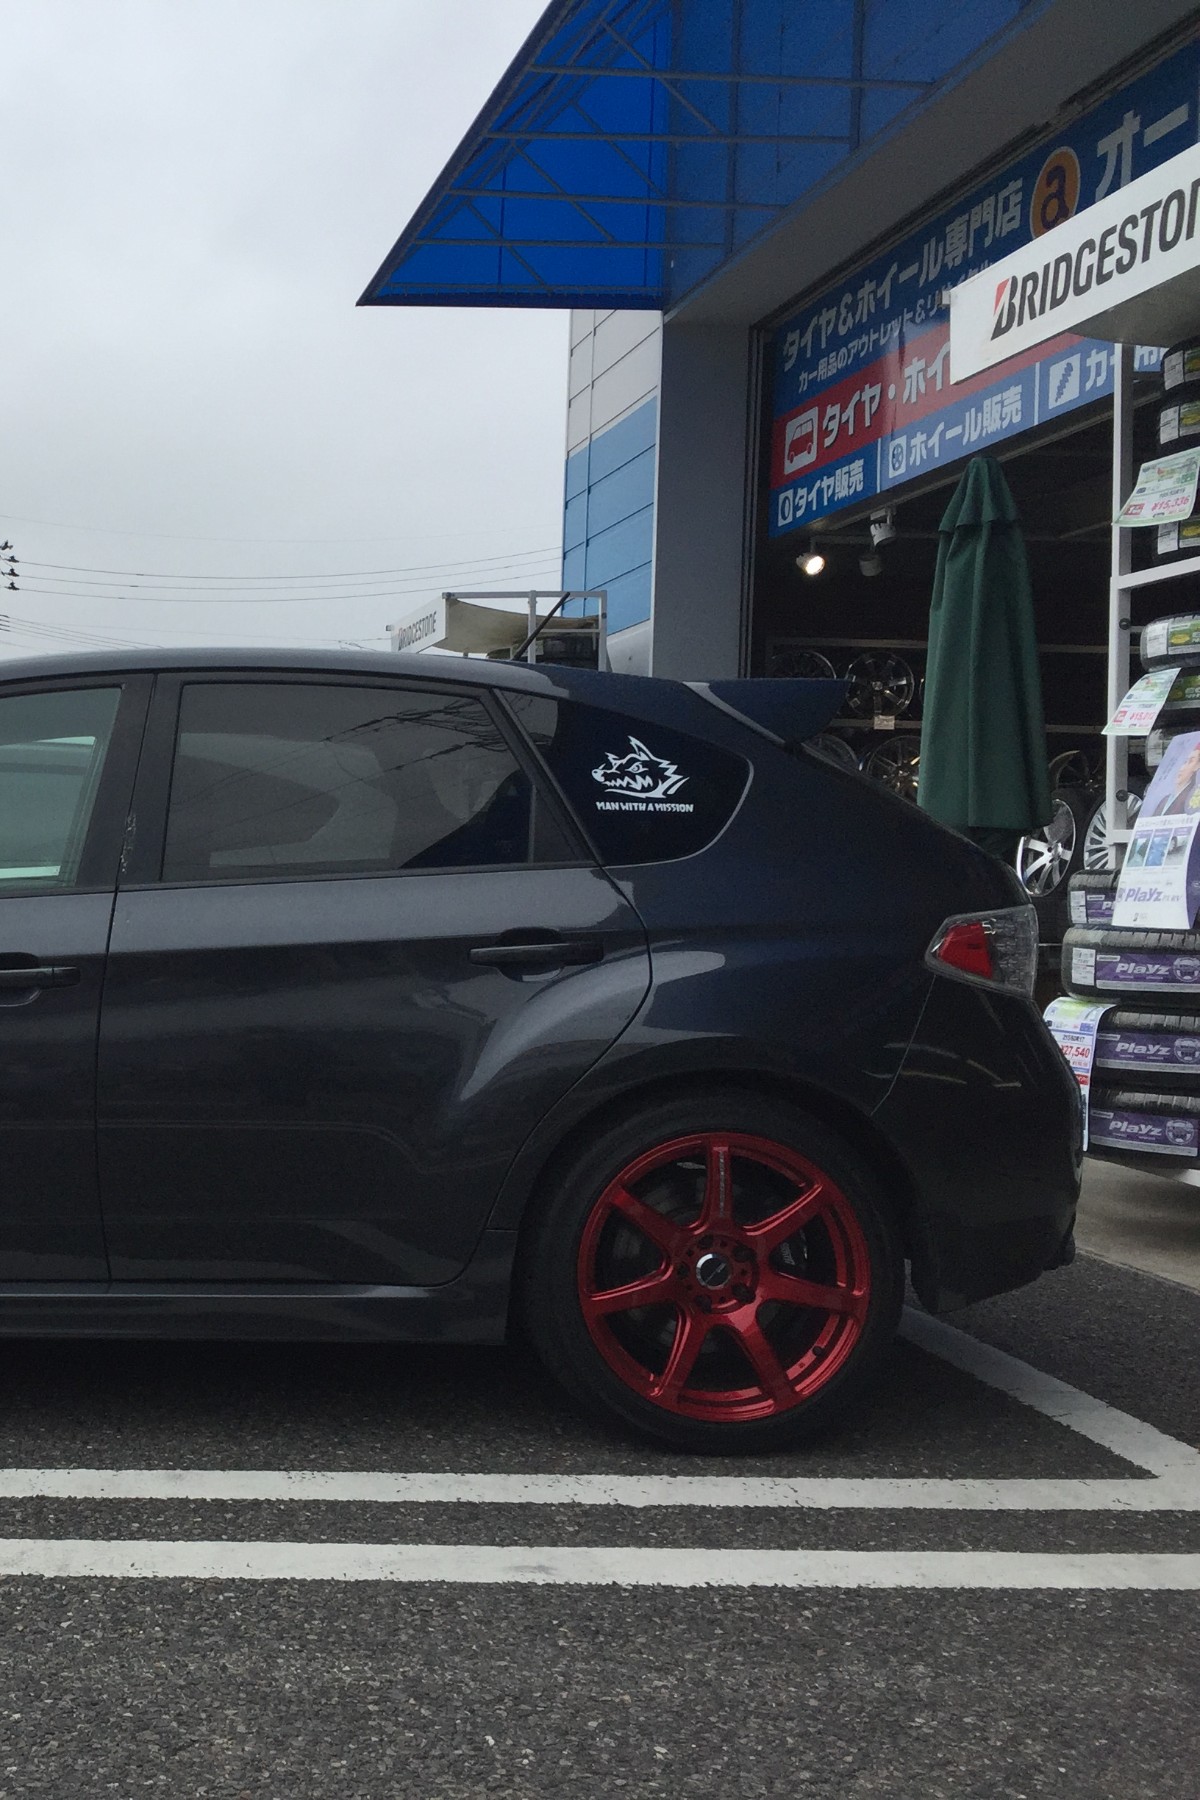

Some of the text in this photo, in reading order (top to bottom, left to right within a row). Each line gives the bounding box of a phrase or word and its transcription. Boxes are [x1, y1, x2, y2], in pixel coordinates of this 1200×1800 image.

[783, 177, 1024, 372] タイヤ&ホイール専門店
[908, 383, 1023, 467] ホイール販売
[794, 458, 865, 518] タイヤ販売
[596, 801, 694, 813] MAN WITH A MISSION
[1115, 962, 1170, 975] Playz
[1115, 1042, 1171, 1056] Playz
[1109, 1120, 1162, 1136] Playz
